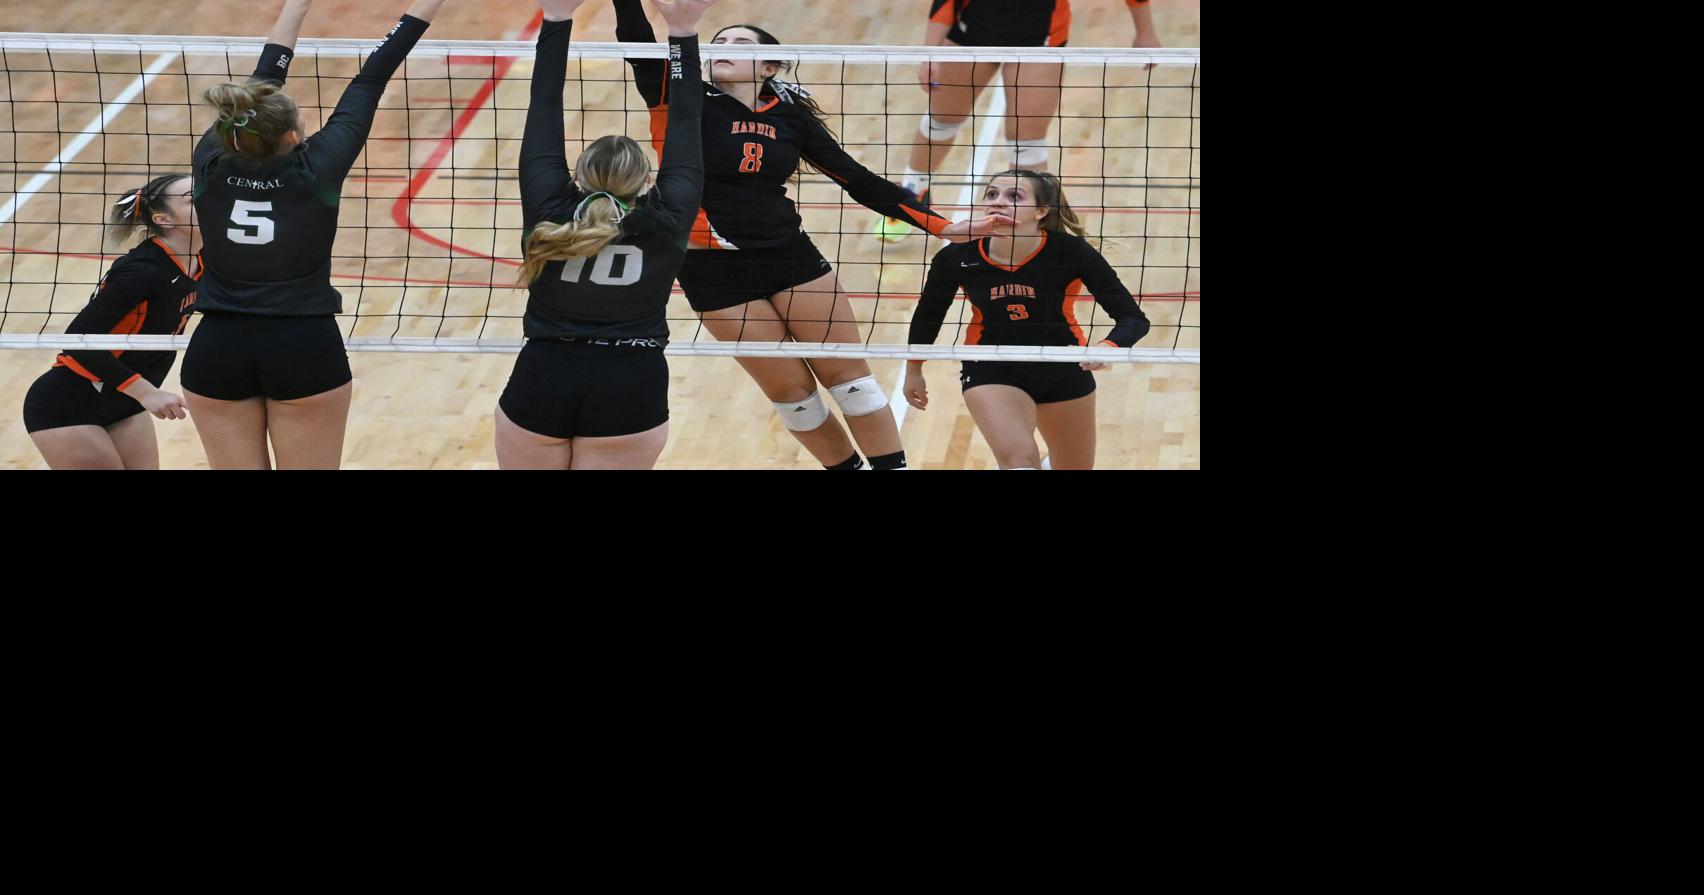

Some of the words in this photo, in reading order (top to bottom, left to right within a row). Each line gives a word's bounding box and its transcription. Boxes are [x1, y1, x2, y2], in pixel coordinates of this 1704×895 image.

[670, 44, 682, 60] WE
[276, 54, 290, 69] BC
[670, 61, 683, 80] ARE
[731, 121, 777, 140] HARDIN
[738, 142, 764, 173] 8
[226, 175, 286, 190] CENTRAL
[226, 199, 275, 245] 5
[990, 284, 1037, 301] HARDIN
[1006, 304, 1030, 321] 3
